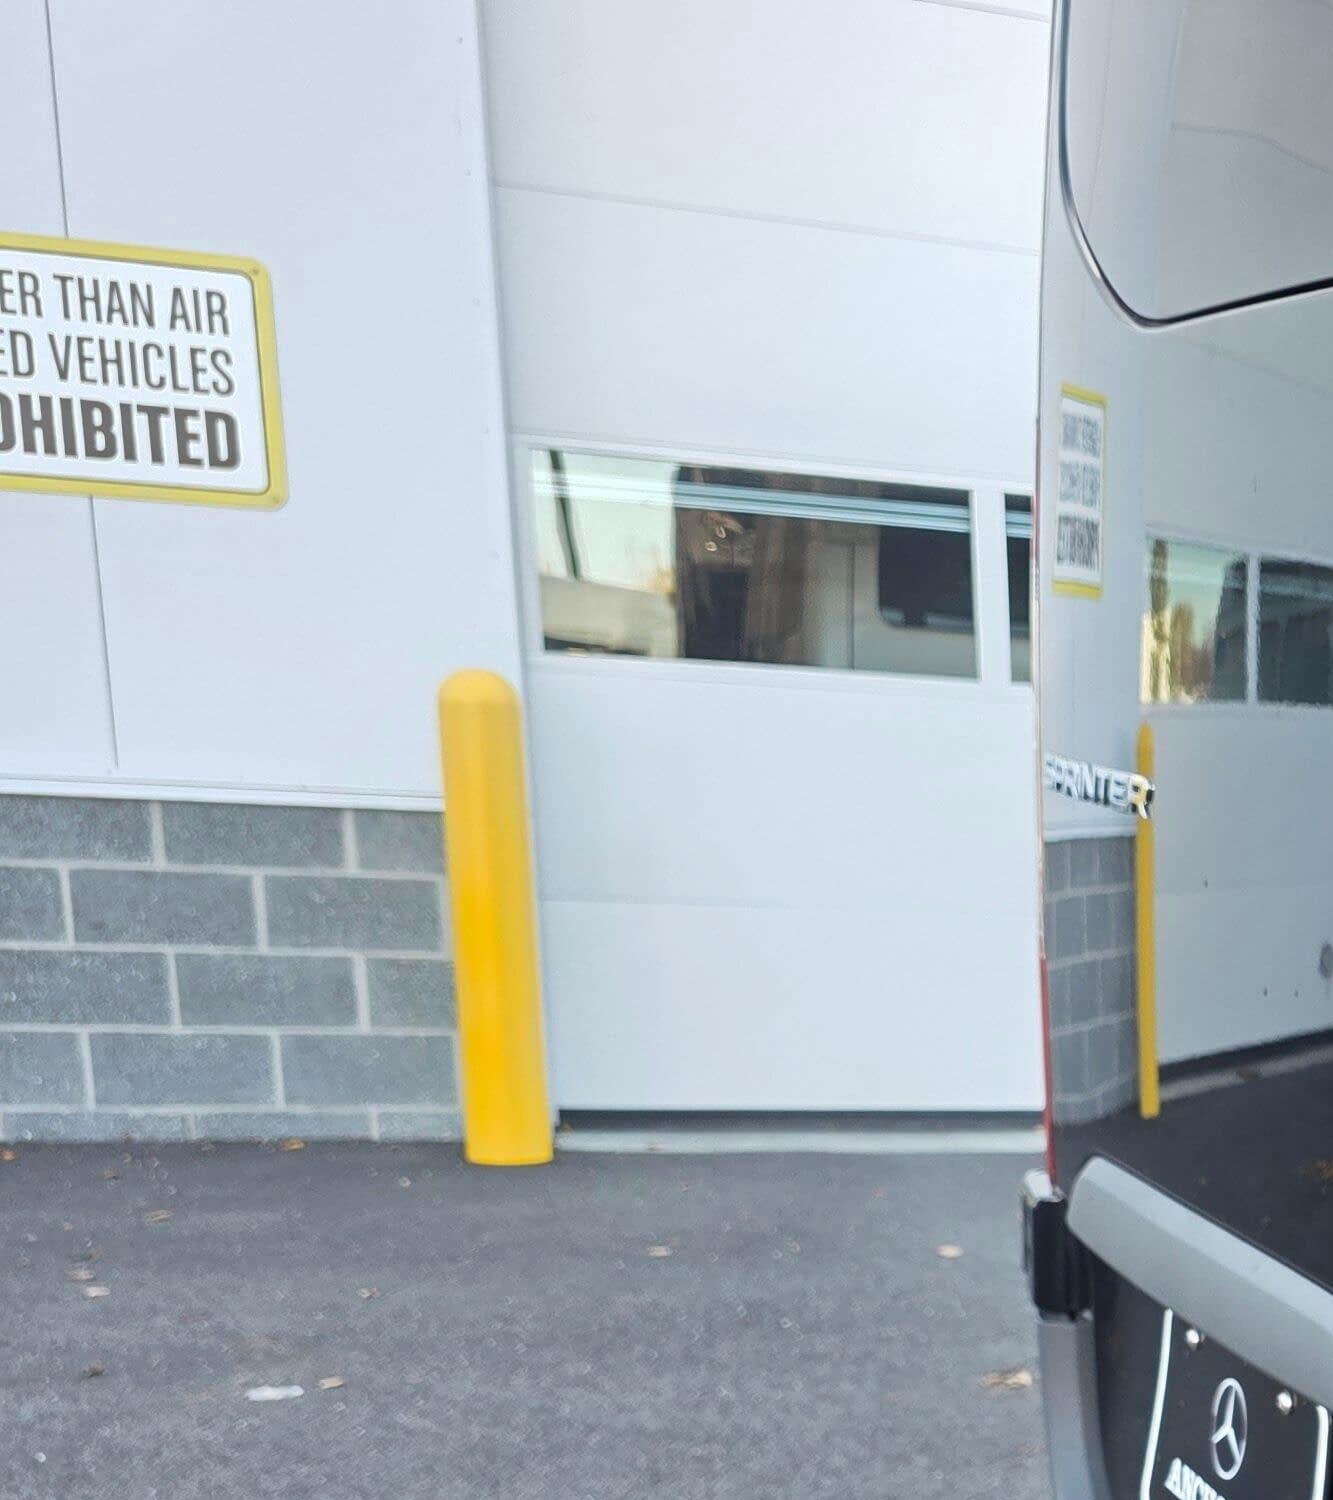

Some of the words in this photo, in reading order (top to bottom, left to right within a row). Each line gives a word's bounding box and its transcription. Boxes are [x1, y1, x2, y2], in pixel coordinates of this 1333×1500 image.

[53, 272, 155, 330] THAN
[169, 286, 230, 337] AIR
[48, 332, 235, 398] VEHICLES
[1044, 752, 1156, 820] SPRINTER
